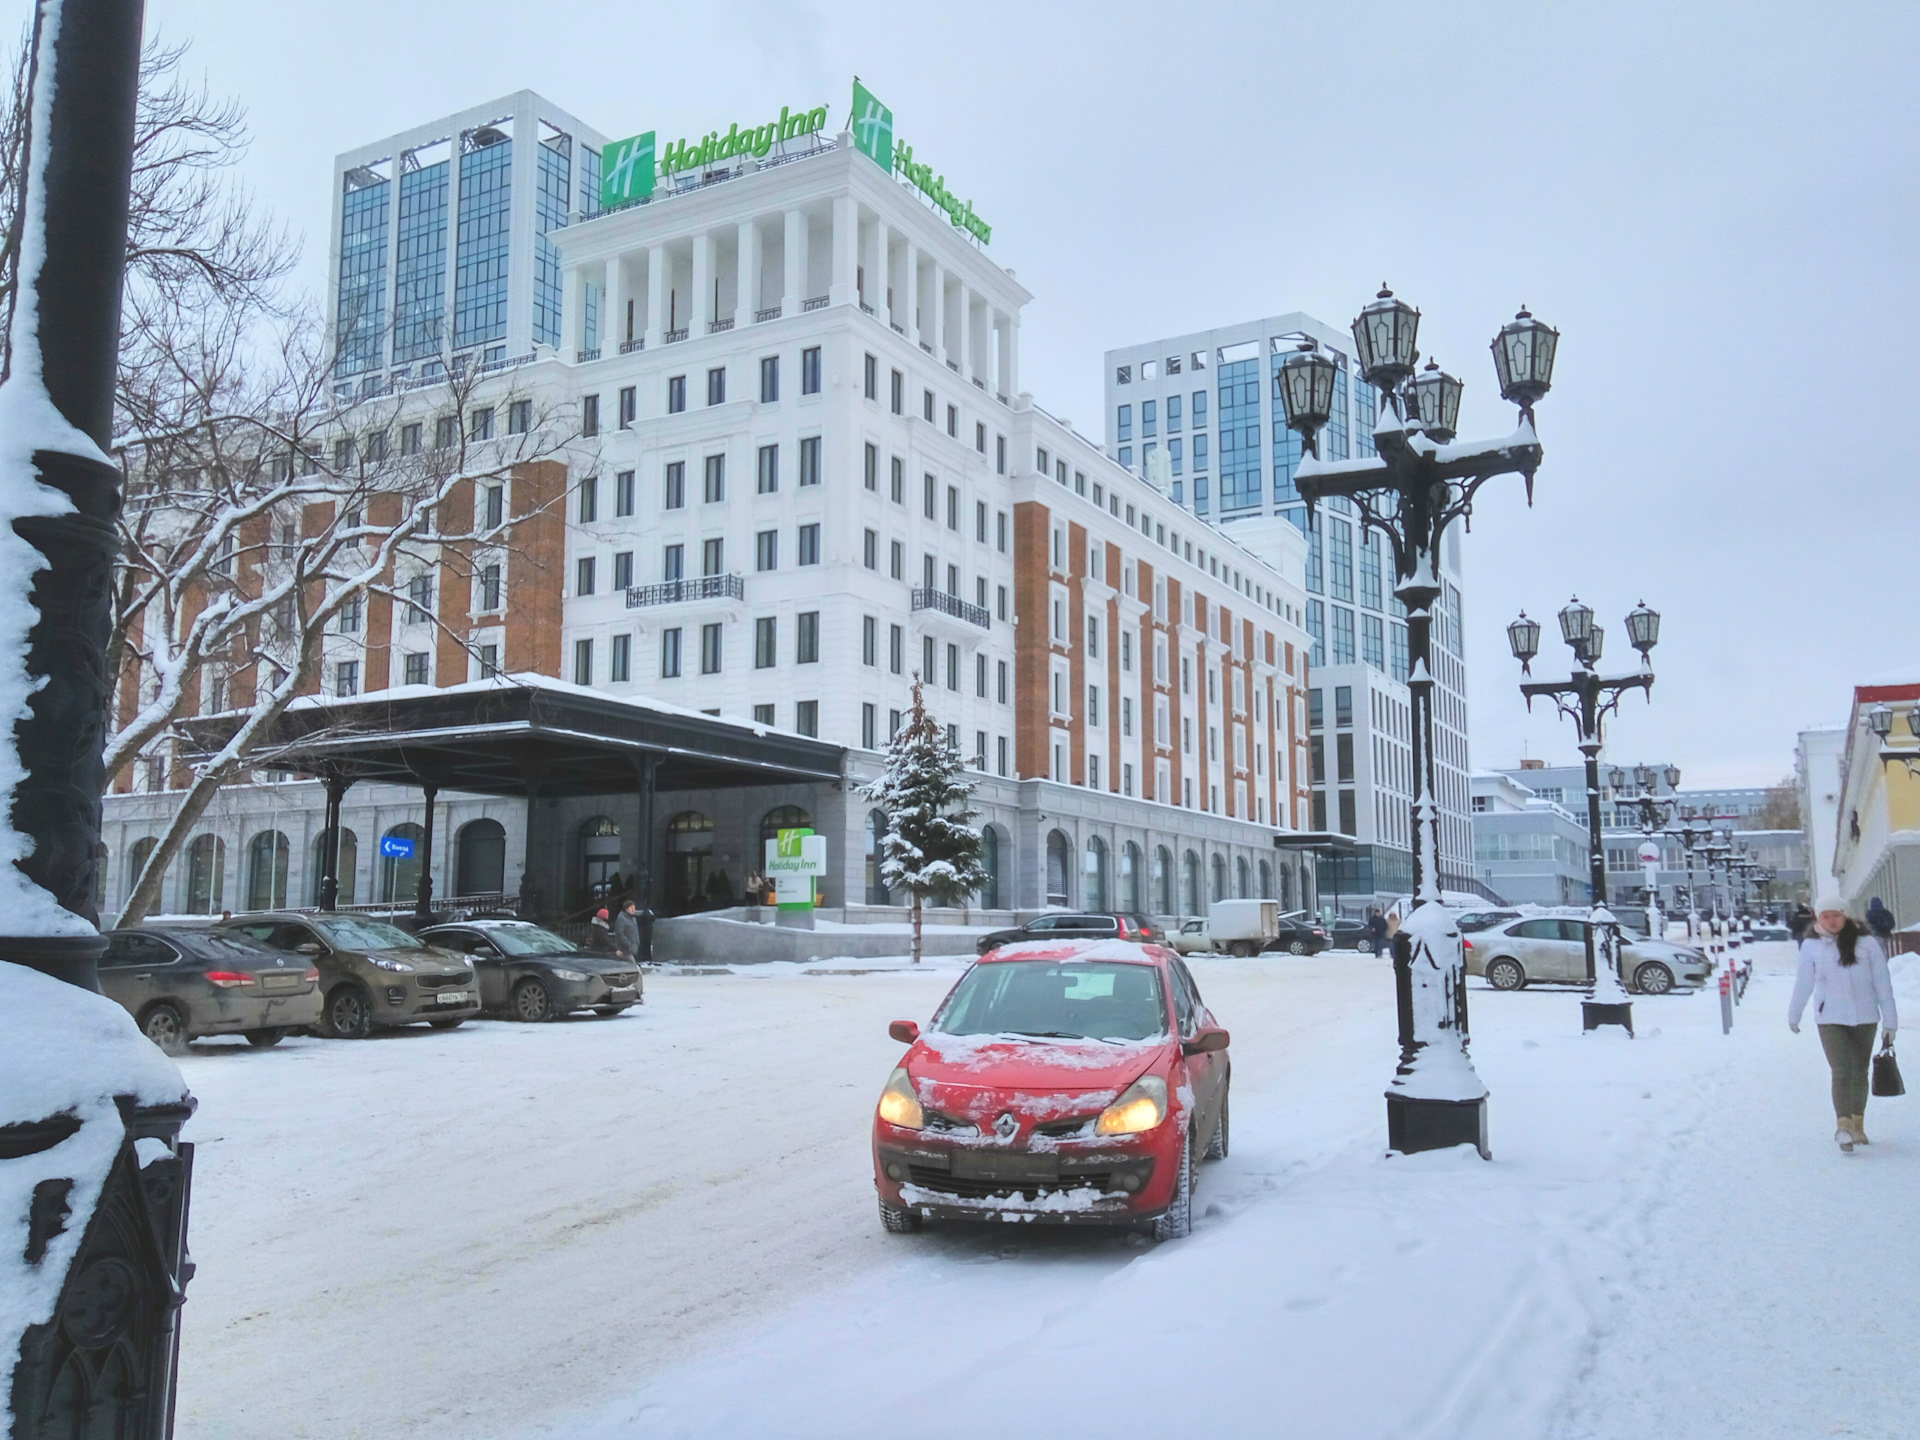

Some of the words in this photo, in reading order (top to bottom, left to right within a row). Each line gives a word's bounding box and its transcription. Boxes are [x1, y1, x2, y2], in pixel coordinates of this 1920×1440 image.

[661, 123, 775, 177] Holiday
[777, 106, 827, 143] Inn
[896, 139, 964, 227] Holiday
[965, 199, 992, 245] Inn
[769, 859, 800, 872] Holiday
[801, 859, 817, 870] Inn
